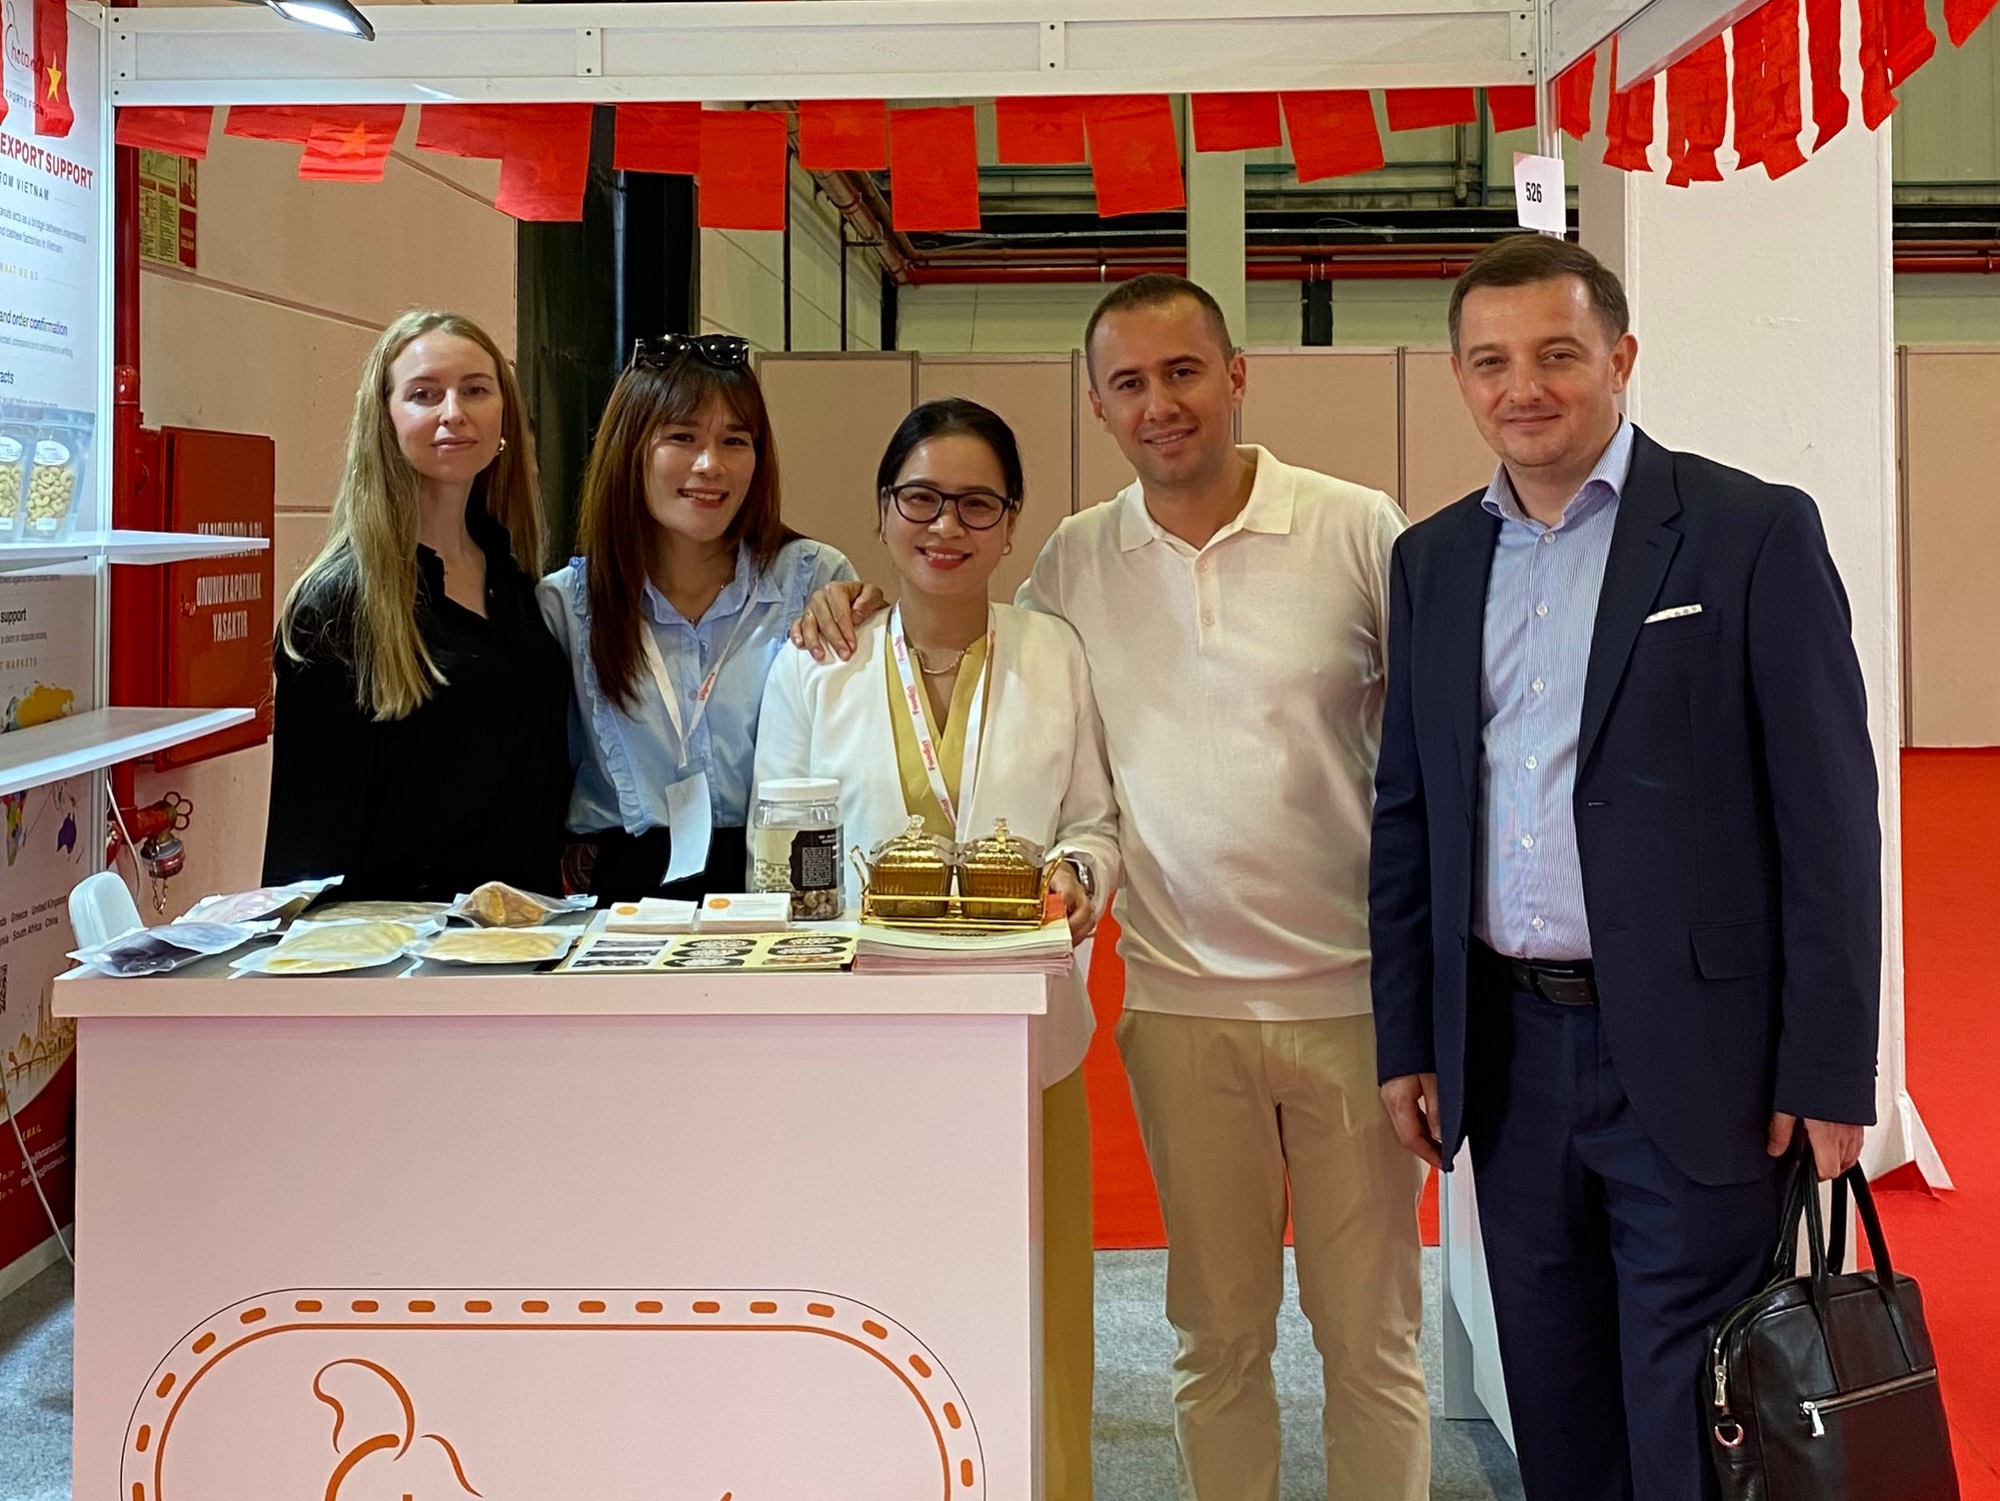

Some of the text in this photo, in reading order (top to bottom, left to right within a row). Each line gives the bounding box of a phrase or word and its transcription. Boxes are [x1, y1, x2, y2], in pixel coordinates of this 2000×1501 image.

[1, 132, 93, 190] EXPORT SUPPORT
[16, 178, 49, 200] VIETNAM
[1526, 182, 1542, 203] 526
[12, 312, 29, 328] order
[30, 318, 68, 336] confirmation
[0, 608, 26, 625] support
[6, 657, 38, 670] MARKETS
